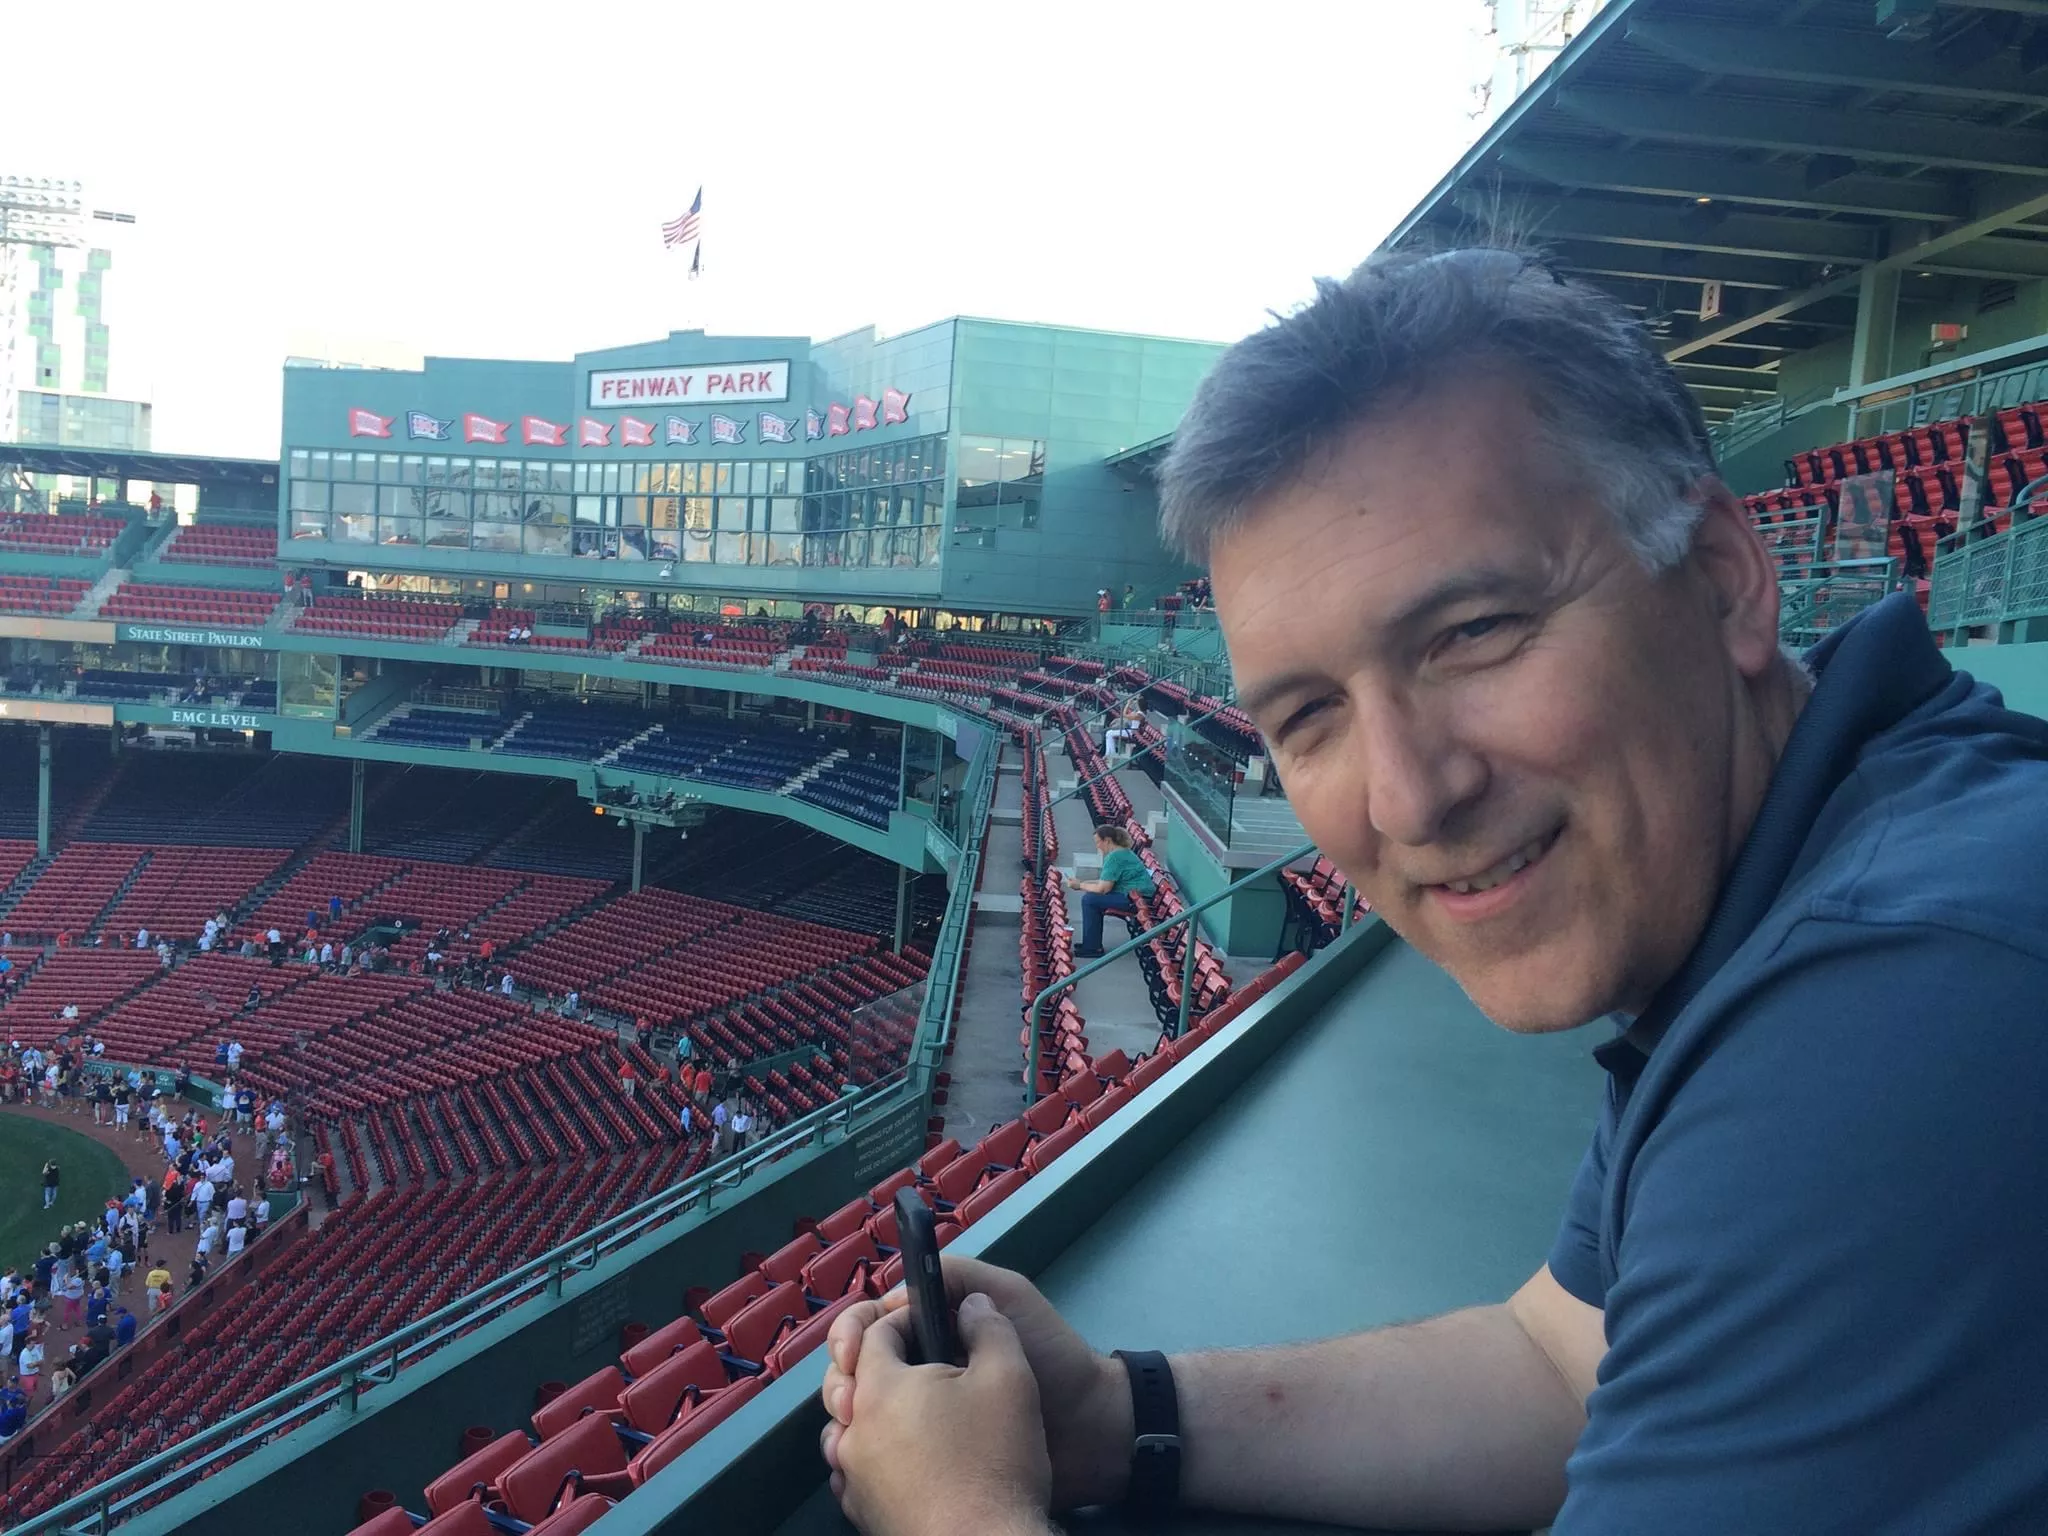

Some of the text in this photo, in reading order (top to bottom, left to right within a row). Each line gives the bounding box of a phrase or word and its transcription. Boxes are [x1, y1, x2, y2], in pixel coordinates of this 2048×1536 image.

[602, 371, 772, 399] FENWAY PARK
[129, 626, 262, 646] STATE STREET PAVILION
[172, 711, 260, 727] EMC LEVEL
